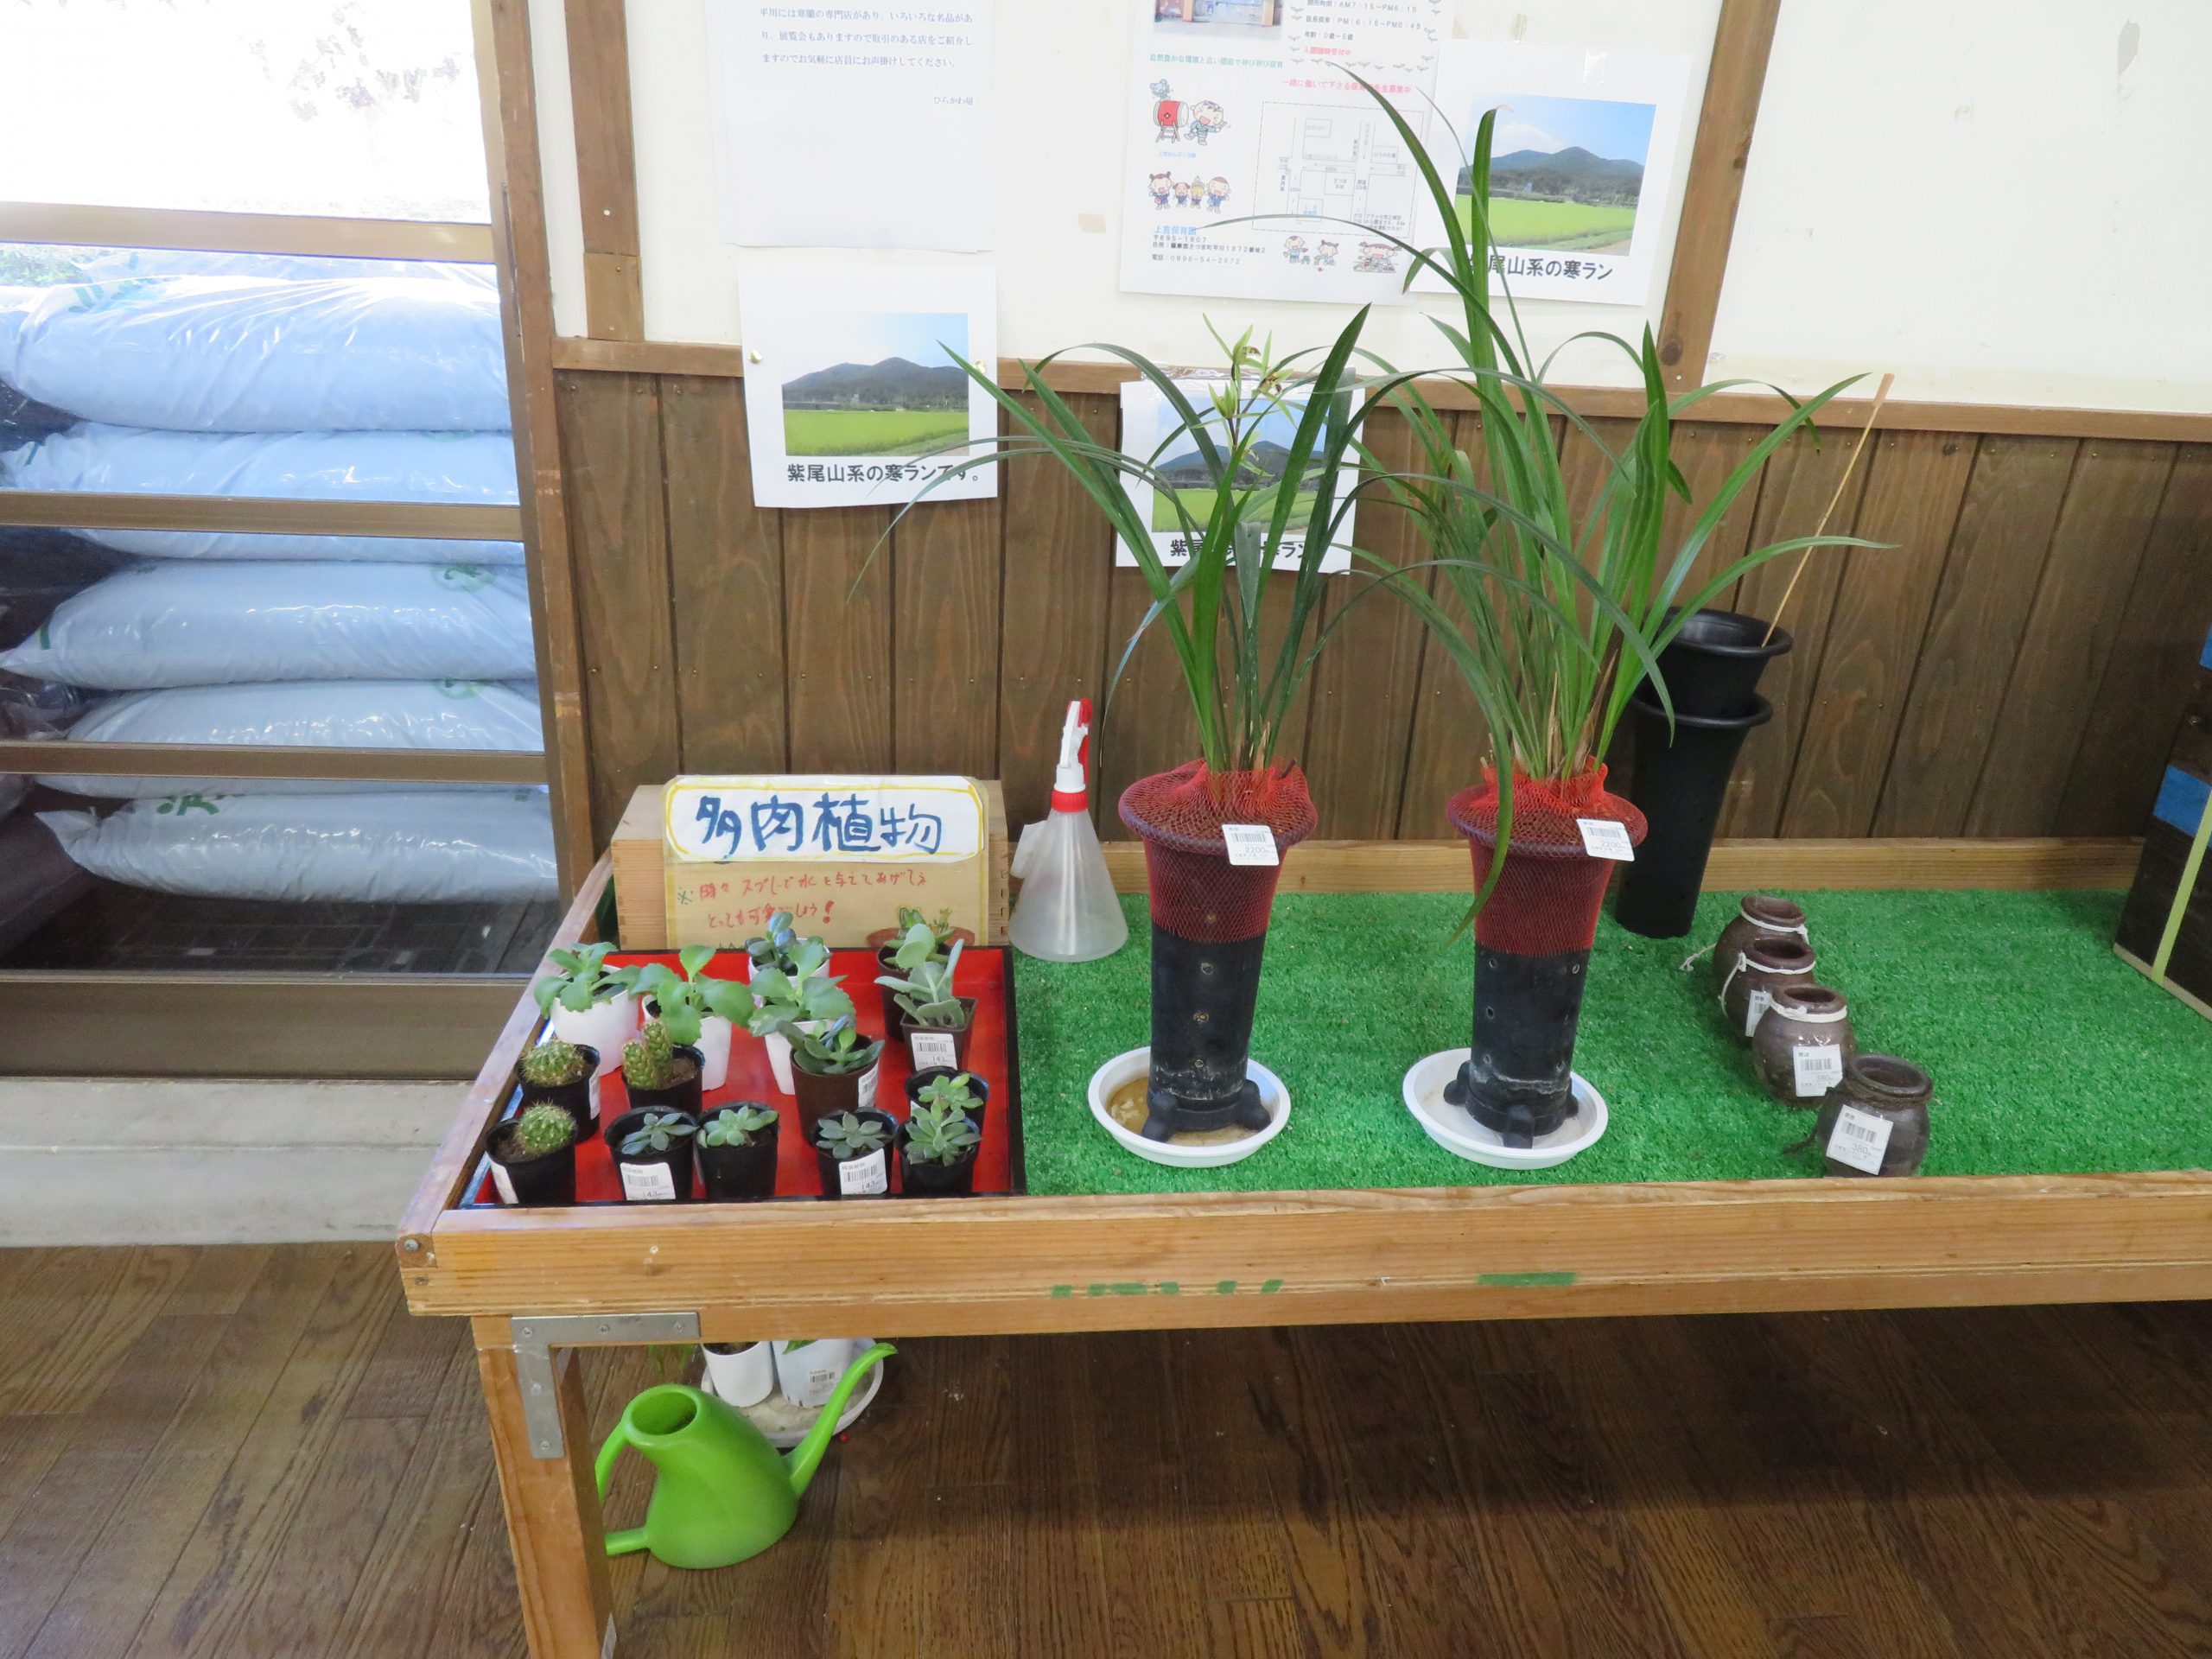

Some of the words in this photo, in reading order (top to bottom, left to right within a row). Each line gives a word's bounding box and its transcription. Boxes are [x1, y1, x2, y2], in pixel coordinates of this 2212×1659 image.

[1470, 254, 1613, 280] 尾山系の寒ラン
[695, 791, 942, 860] 多肉植物
